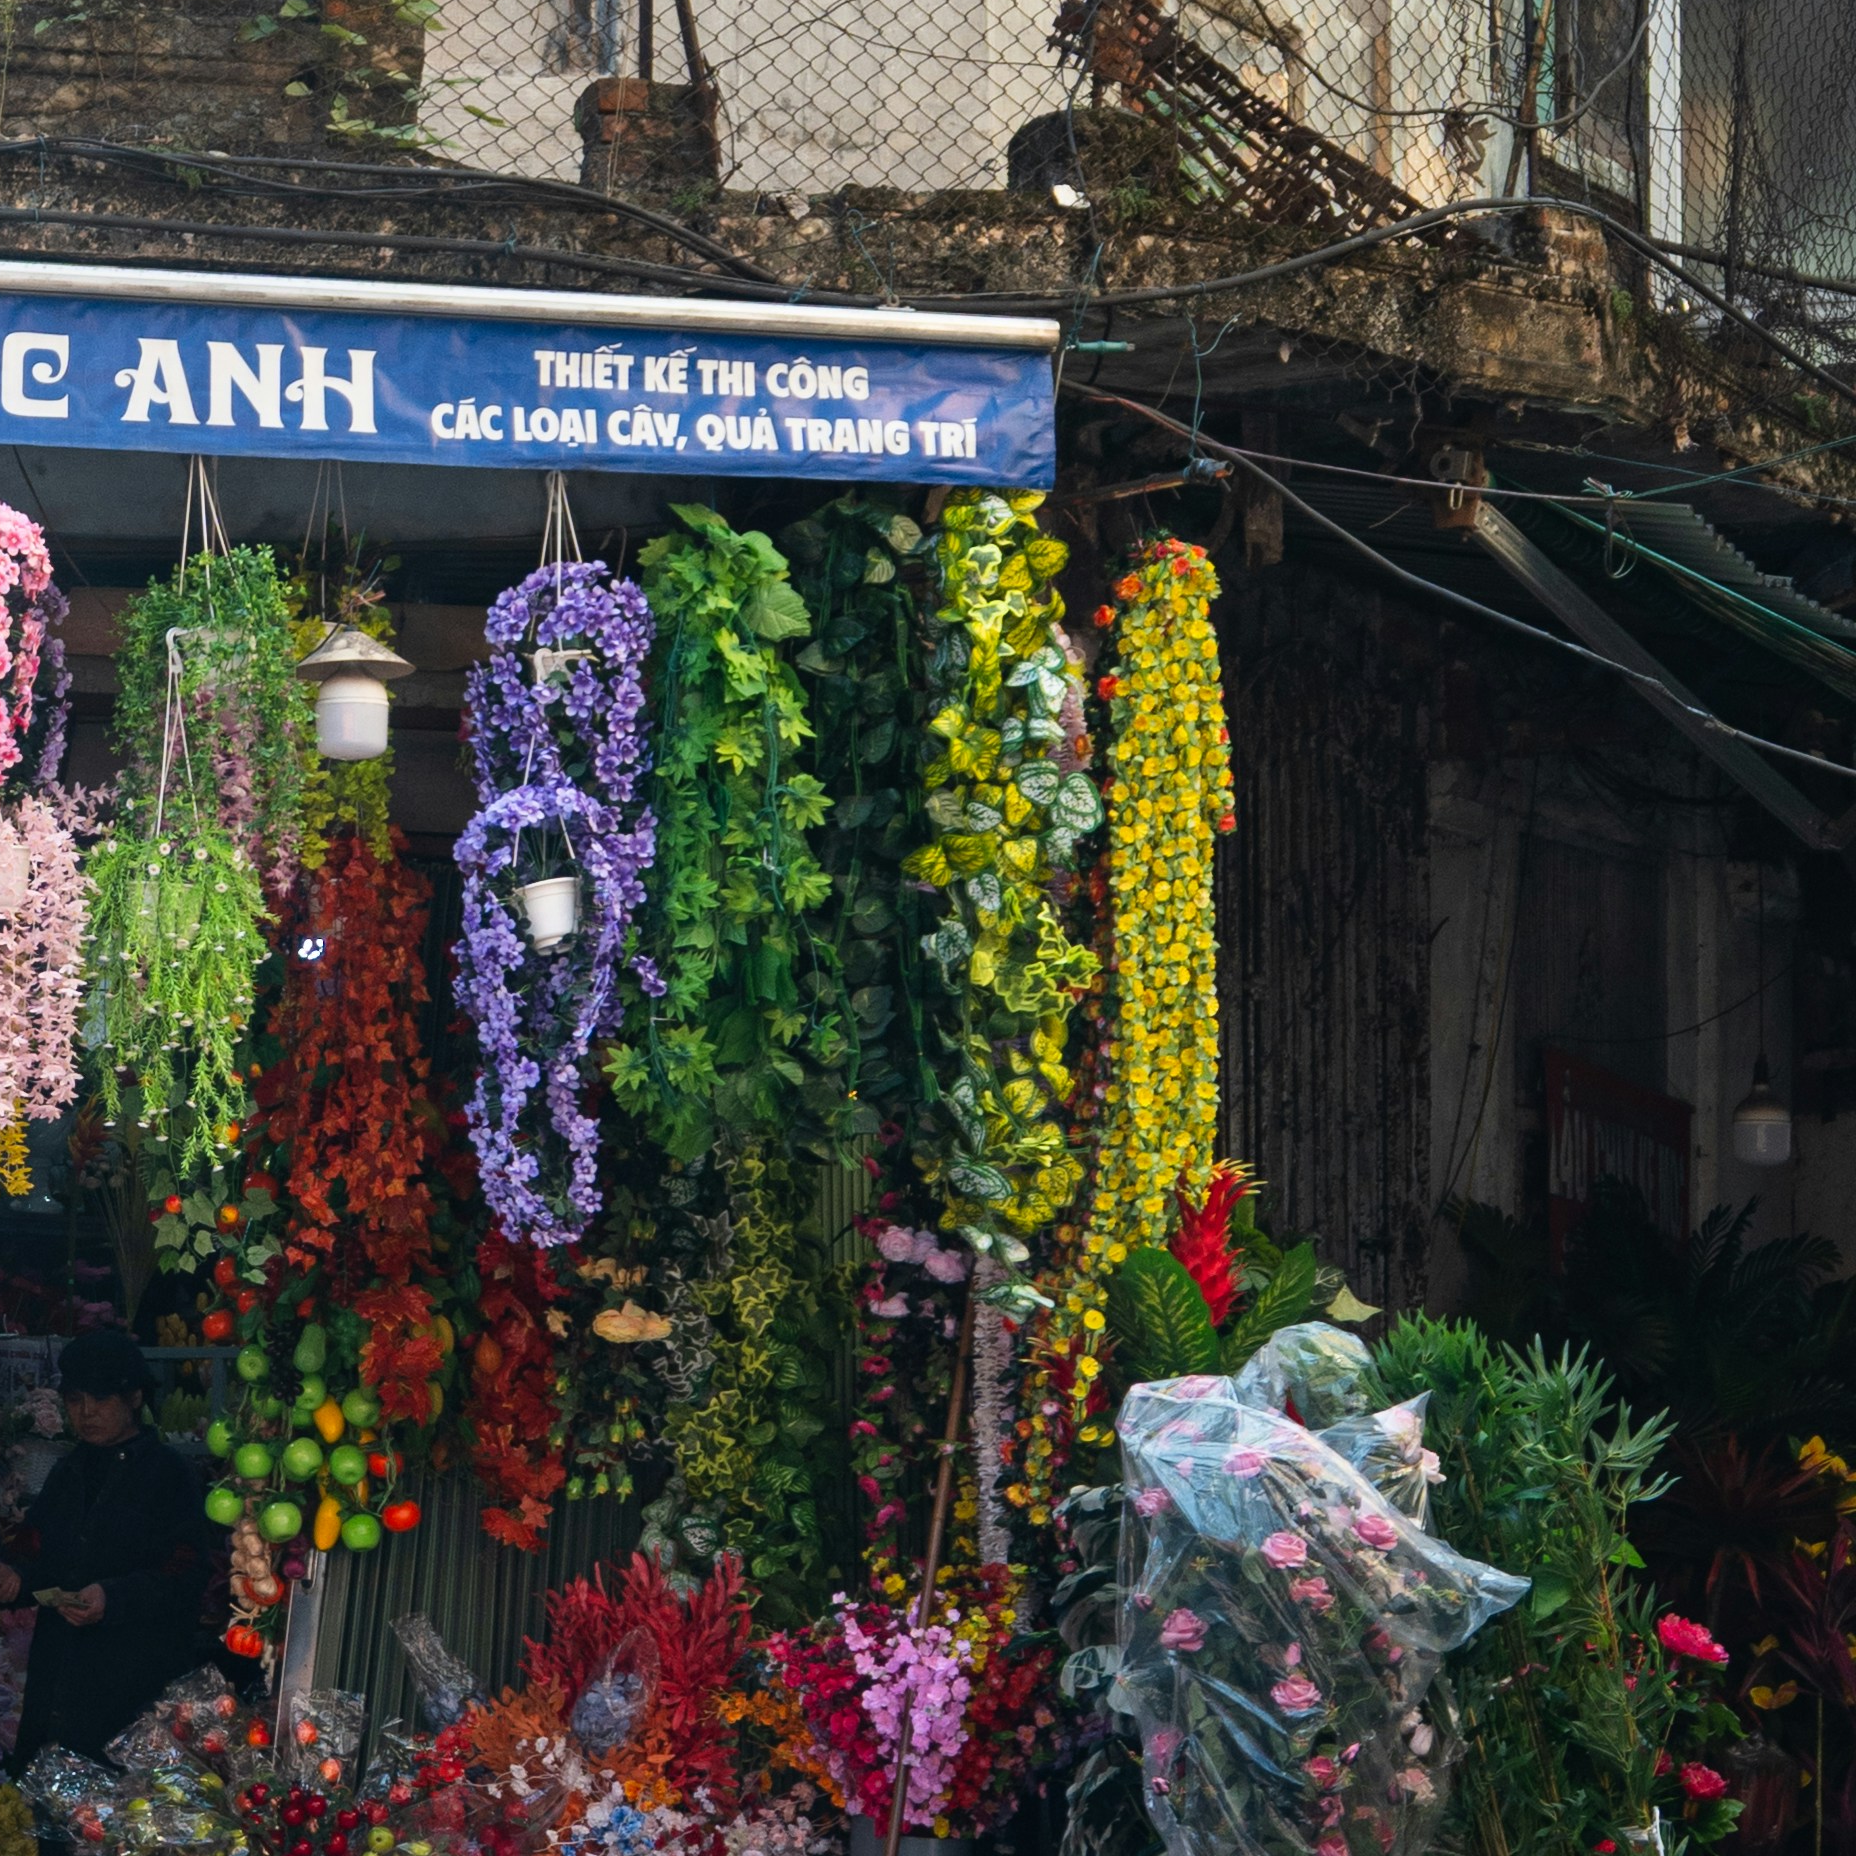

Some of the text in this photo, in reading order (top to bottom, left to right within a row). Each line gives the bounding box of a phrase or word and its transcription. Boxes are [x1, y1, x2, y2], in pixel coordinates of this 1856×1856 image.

[114, 337, 378, 435] ANH
[534, 342, 870, 401] THIẾT KẾ THI CÔNG
[431, 397, 978, 459] CÁC LOẠI CÂY, QUẢ TRANG TRÍ
